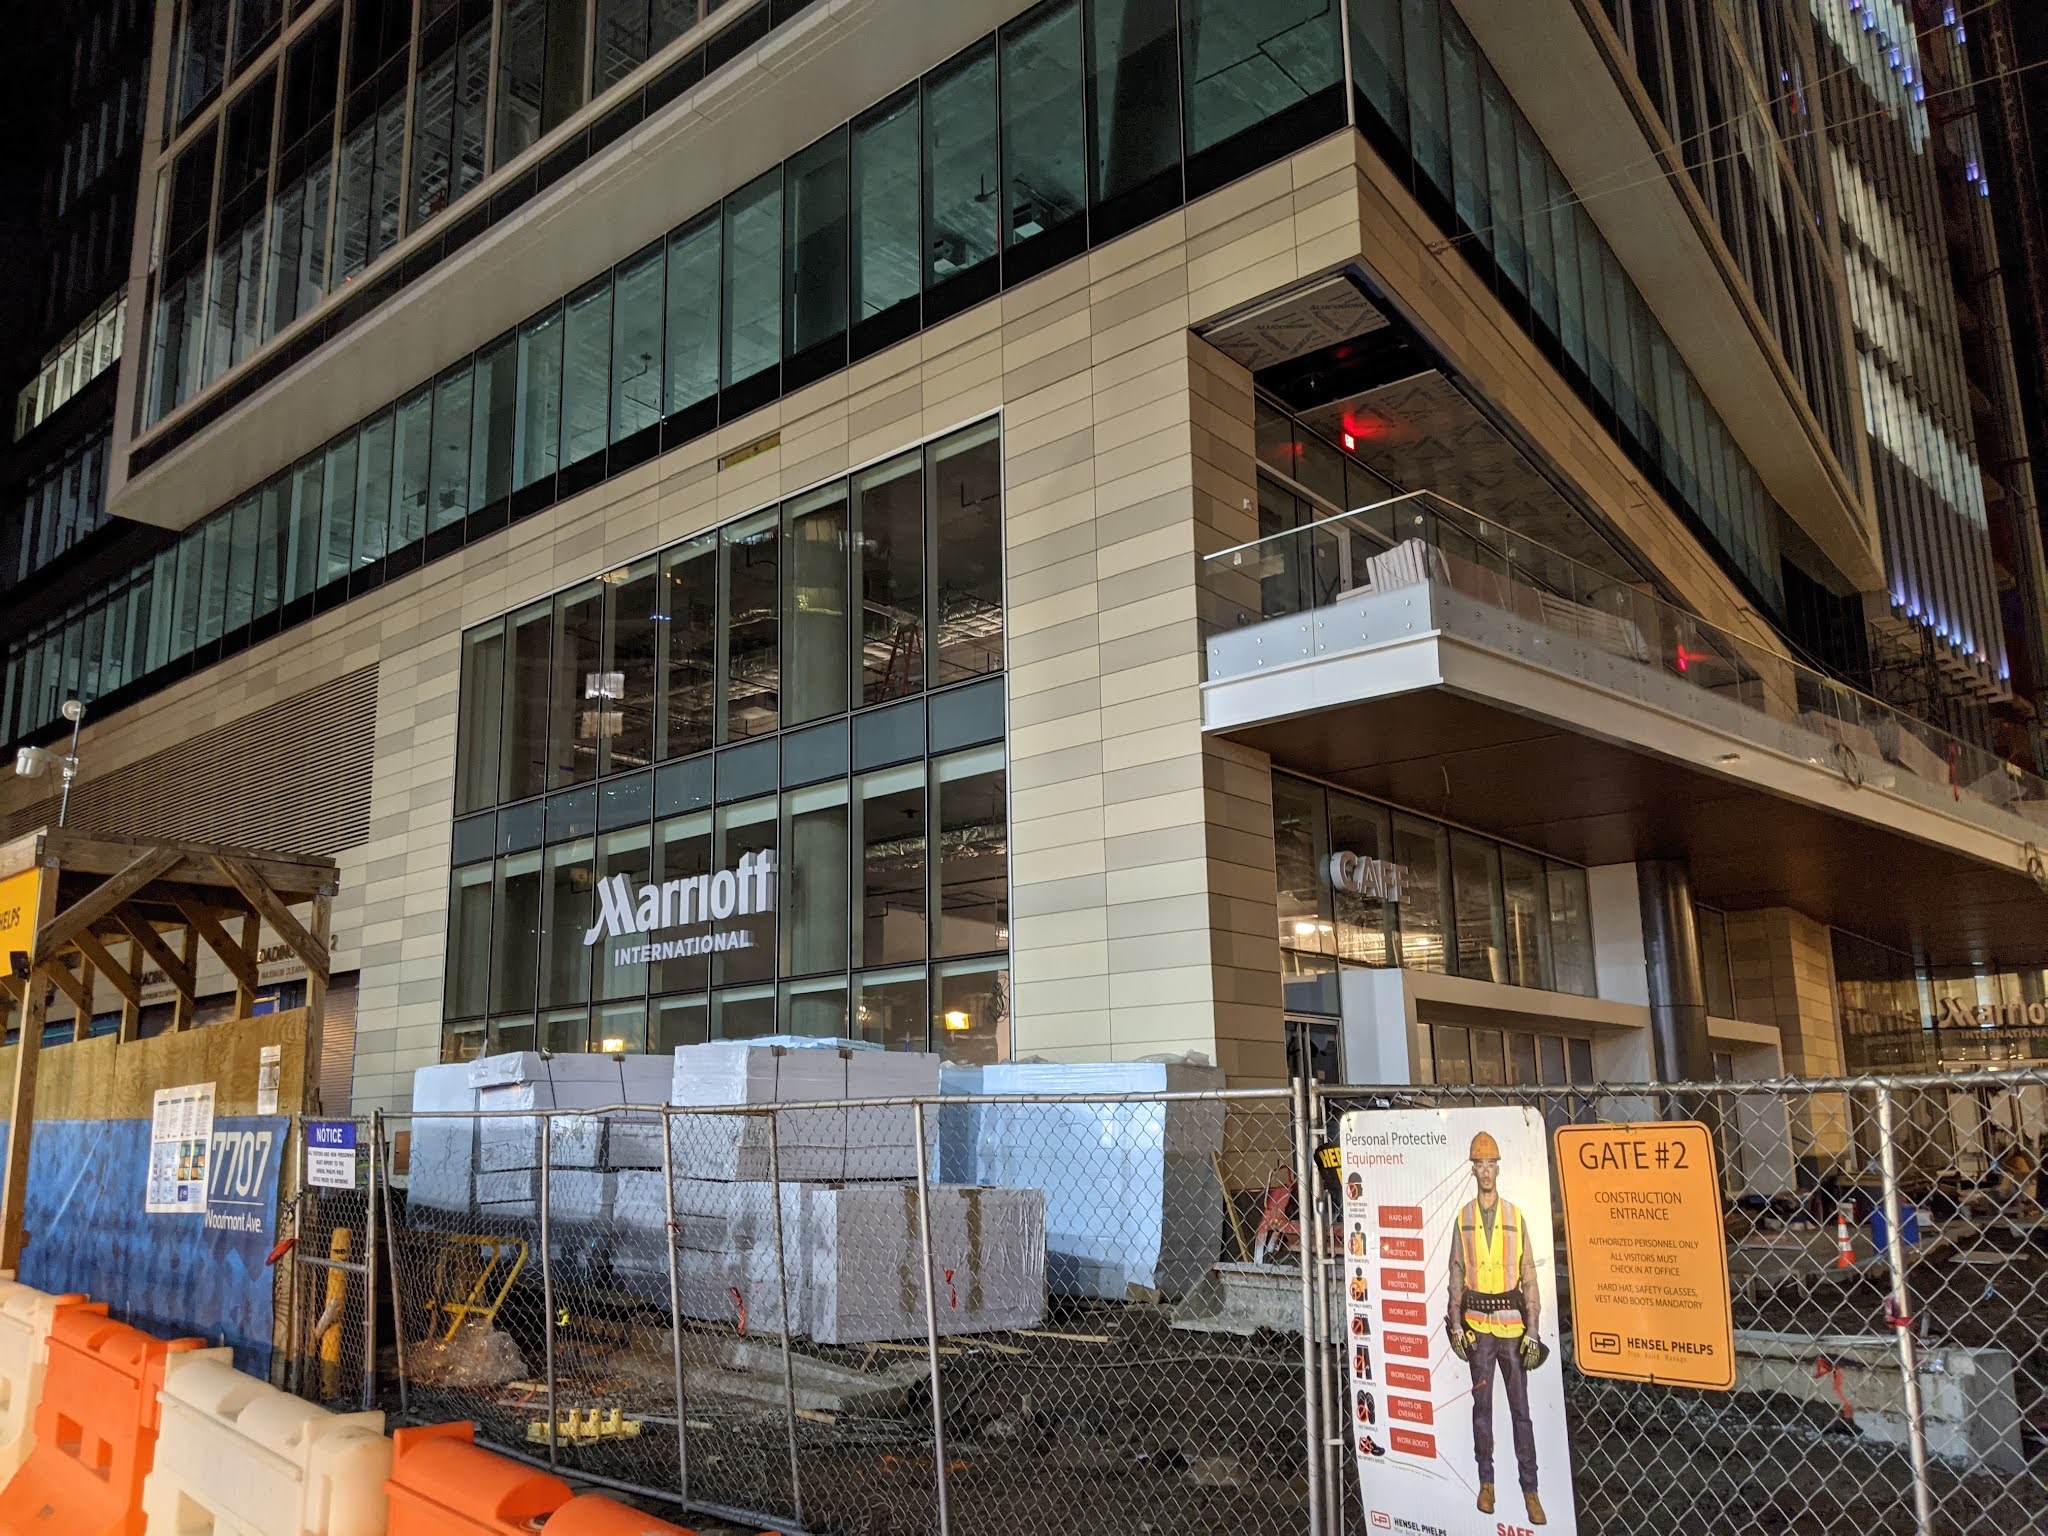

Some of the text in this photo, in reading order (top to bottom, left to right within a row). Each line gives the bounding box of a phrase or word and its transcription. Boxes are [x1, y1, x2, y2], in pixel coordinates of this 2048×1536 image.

[584, 848, 777, 946] Marriott
[331, 934, 339, 951] 2
[614, 929, 755, 967] INTERNATIONAL
[1938, 997, 2048, 1028] Marrio
[316, 1127, 343, 1144] NOTICE
[1345, 1131, 1447, 1146] Personal Protective
[1346, 1151, 1404, 1168] Equipment
[1579, 1141, 1689, 1170] GATE #2
[210, 1131, 273, 1197] 7707
[1594, 1191, 1682, 1204] CONSTRUCTION
[1610, 1207, 1670, 1221] ENTRANCE
[245, 1212, 263, 1233] Ave.
[1589, 1237, 1699, 1249] AUTHORIZED PERSONNEL ONLY
[1387, 1249, 1417, 1257] PROTECTION
[1610, 1252, 1678, 1264] ALL VISITORS MUST
[1610, 1264, 1680, 1276] CHECK IN AT OFFICE
[1388, 1280, 1418, 1289] PROTECTION
[1597, 1282, 1698, 1297] HARD HAT, SAFETY GLASSES,
[1594, 1294, 1703, 1310] VEST AND BOOTS MANDATORY
[1388, 1308, 1419, 1317] WORK SHIRT
[1386, 1334, 1423, 1345] HIGH VISIBILITY
[1627, 1336, 1714, 1356] HENSEL PHELPS
[1400, 1345, 1412, 1353] VEST
[1390, 1371, 1425, 1383] WORK GLOVES
[1397, 1399, 1422, 1410] PANTS OR
[1396, 1436, 1430, 1449] WORK BOOTS
[1393, 1517, 1420, 1531] HENSEL
